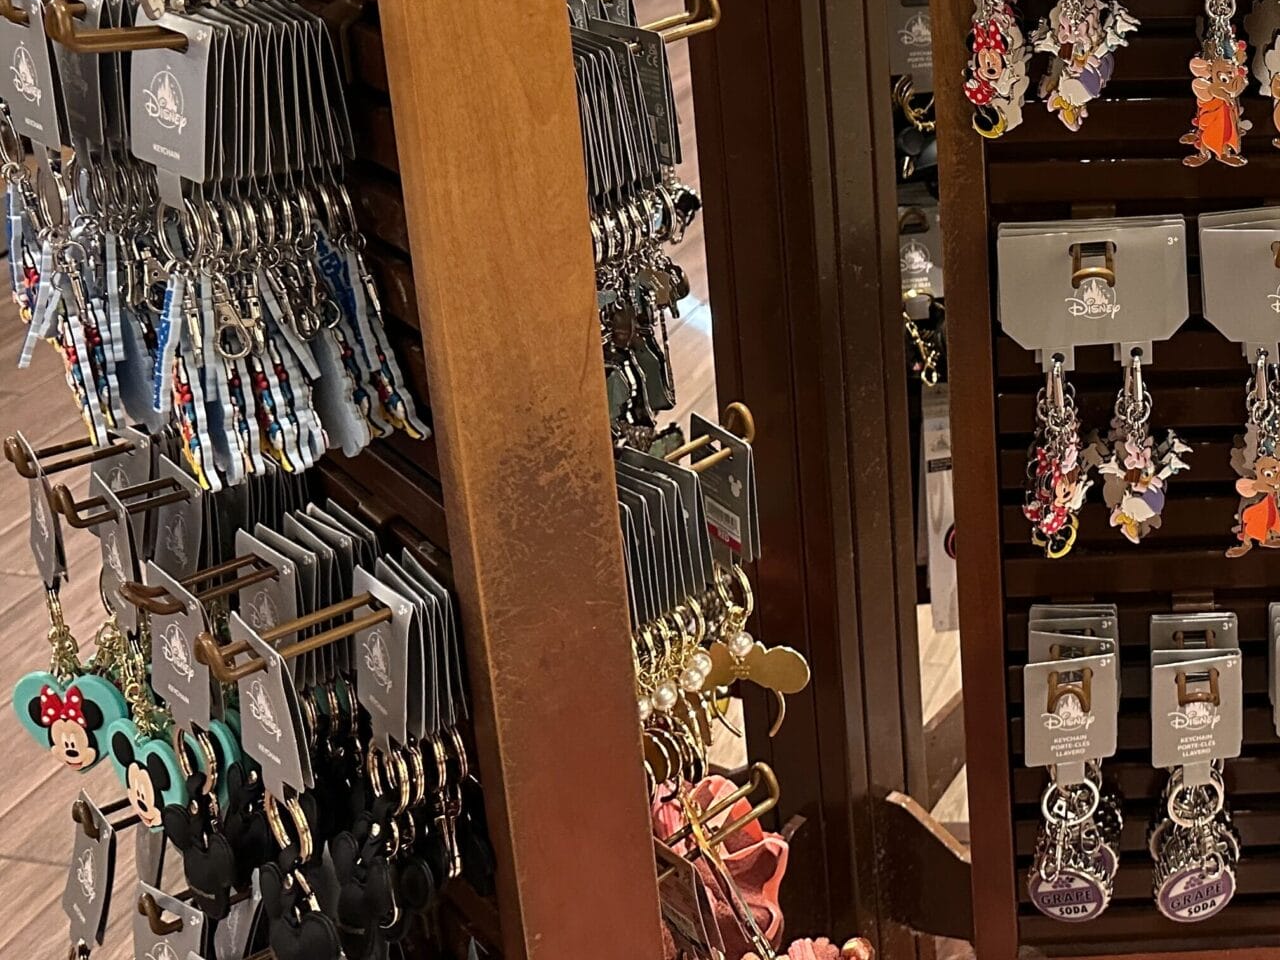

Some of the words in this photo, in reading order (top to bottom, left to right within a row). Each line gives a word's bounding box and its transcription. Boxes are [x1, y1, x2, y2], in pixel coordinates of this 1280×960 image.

[143, 89, 188, 136] Disney
[152, 143, 181, 161] KEYCHAIN
[1167, 236, 1179, 246] 3+
[1065, 297, 1121, 320] Disney
[1101, 620, 1112, 629] 3+
[1222, 622, 1233, 631] 3+
[1100, 642, 1111, 651] 3+
[160, 633, 195, 684] Disney
[1100, 658, 1111, 667] 3+
[1226, 659, 1238, 668] 3+
[1040, 711, 1096, 731] Disney
[1167, 709, 1222, 730] Disney
[1053, 734, 1088, 744] KEYCHAIN
[1180, 734, 1213, 744] KEYCHAIN
[1056, 748, 1086, 758] LLAVERO
[1182, 748, 1211, 758] LLAVERO
[1040, 889, 1093, 906] GRAPE
[1170, 881, 1223, 911] GRAPE
[1058, 905, 1089, 916] SODA
[1187, 899, 1217, 917] SODA
